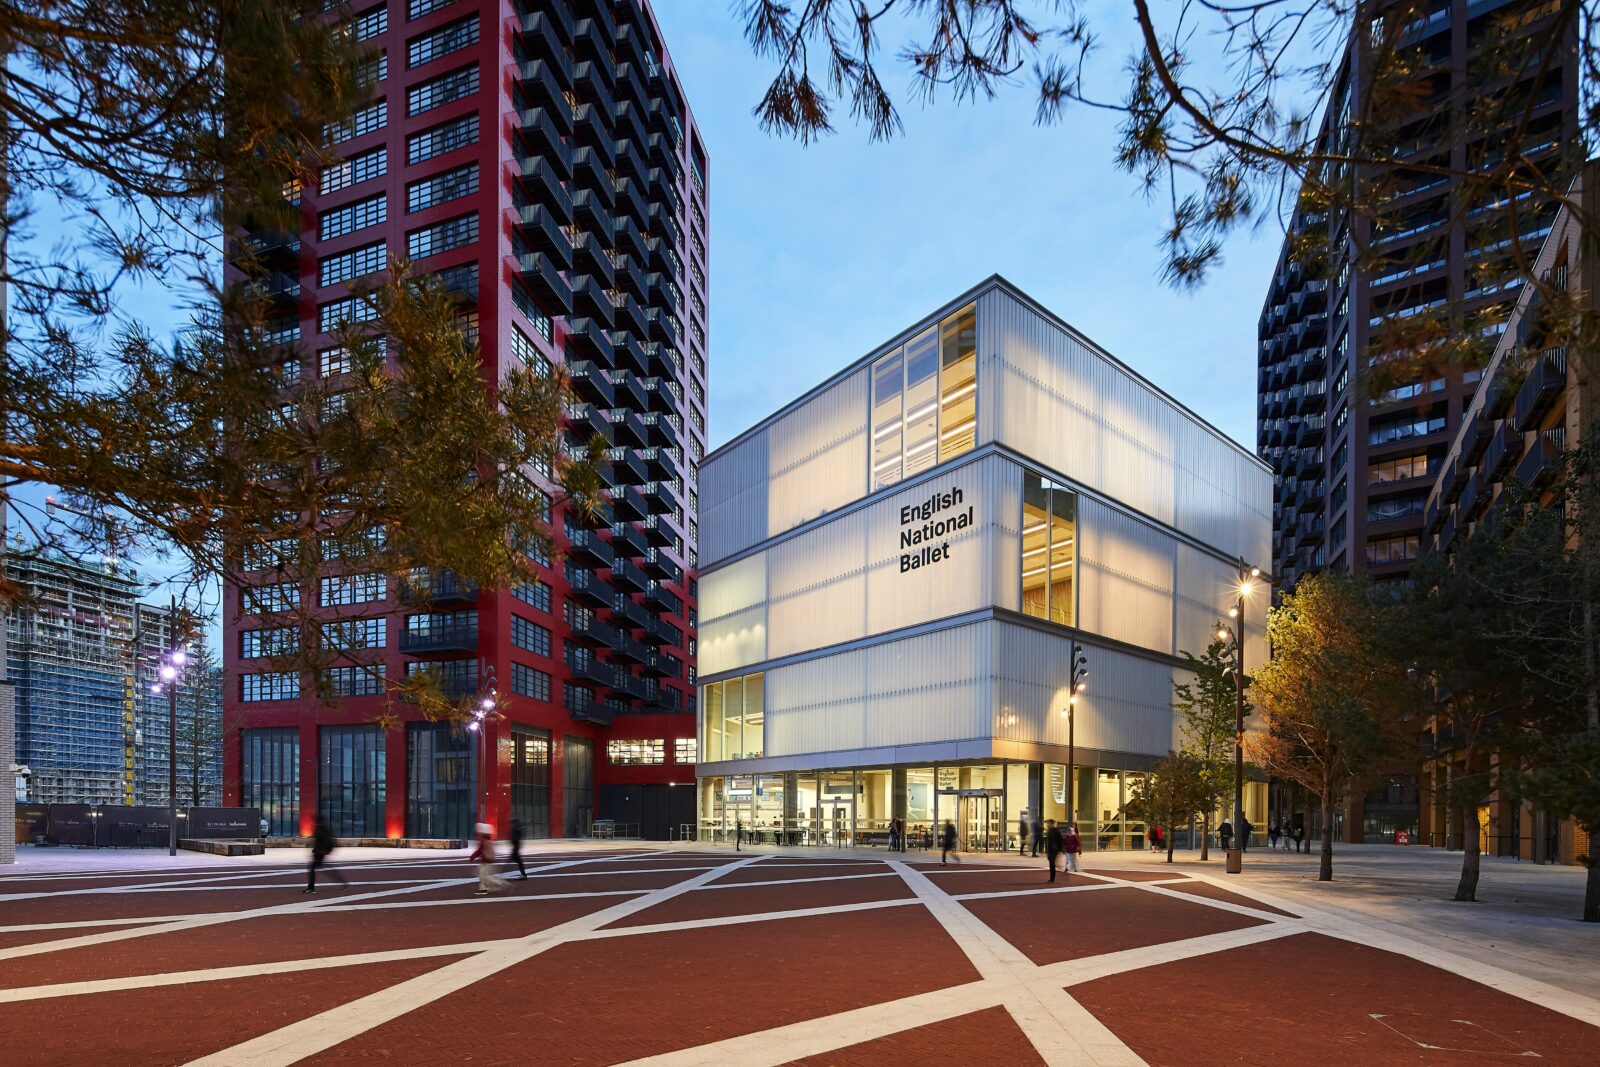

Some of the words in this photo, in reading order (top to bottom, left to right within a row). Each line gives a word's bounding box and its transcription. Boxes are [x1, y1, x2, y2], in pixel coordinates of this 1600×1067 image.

[900, 487, 963, 525] English
[900, 506, 973, 549] National
[900, 542, 950, 573] Ballet
